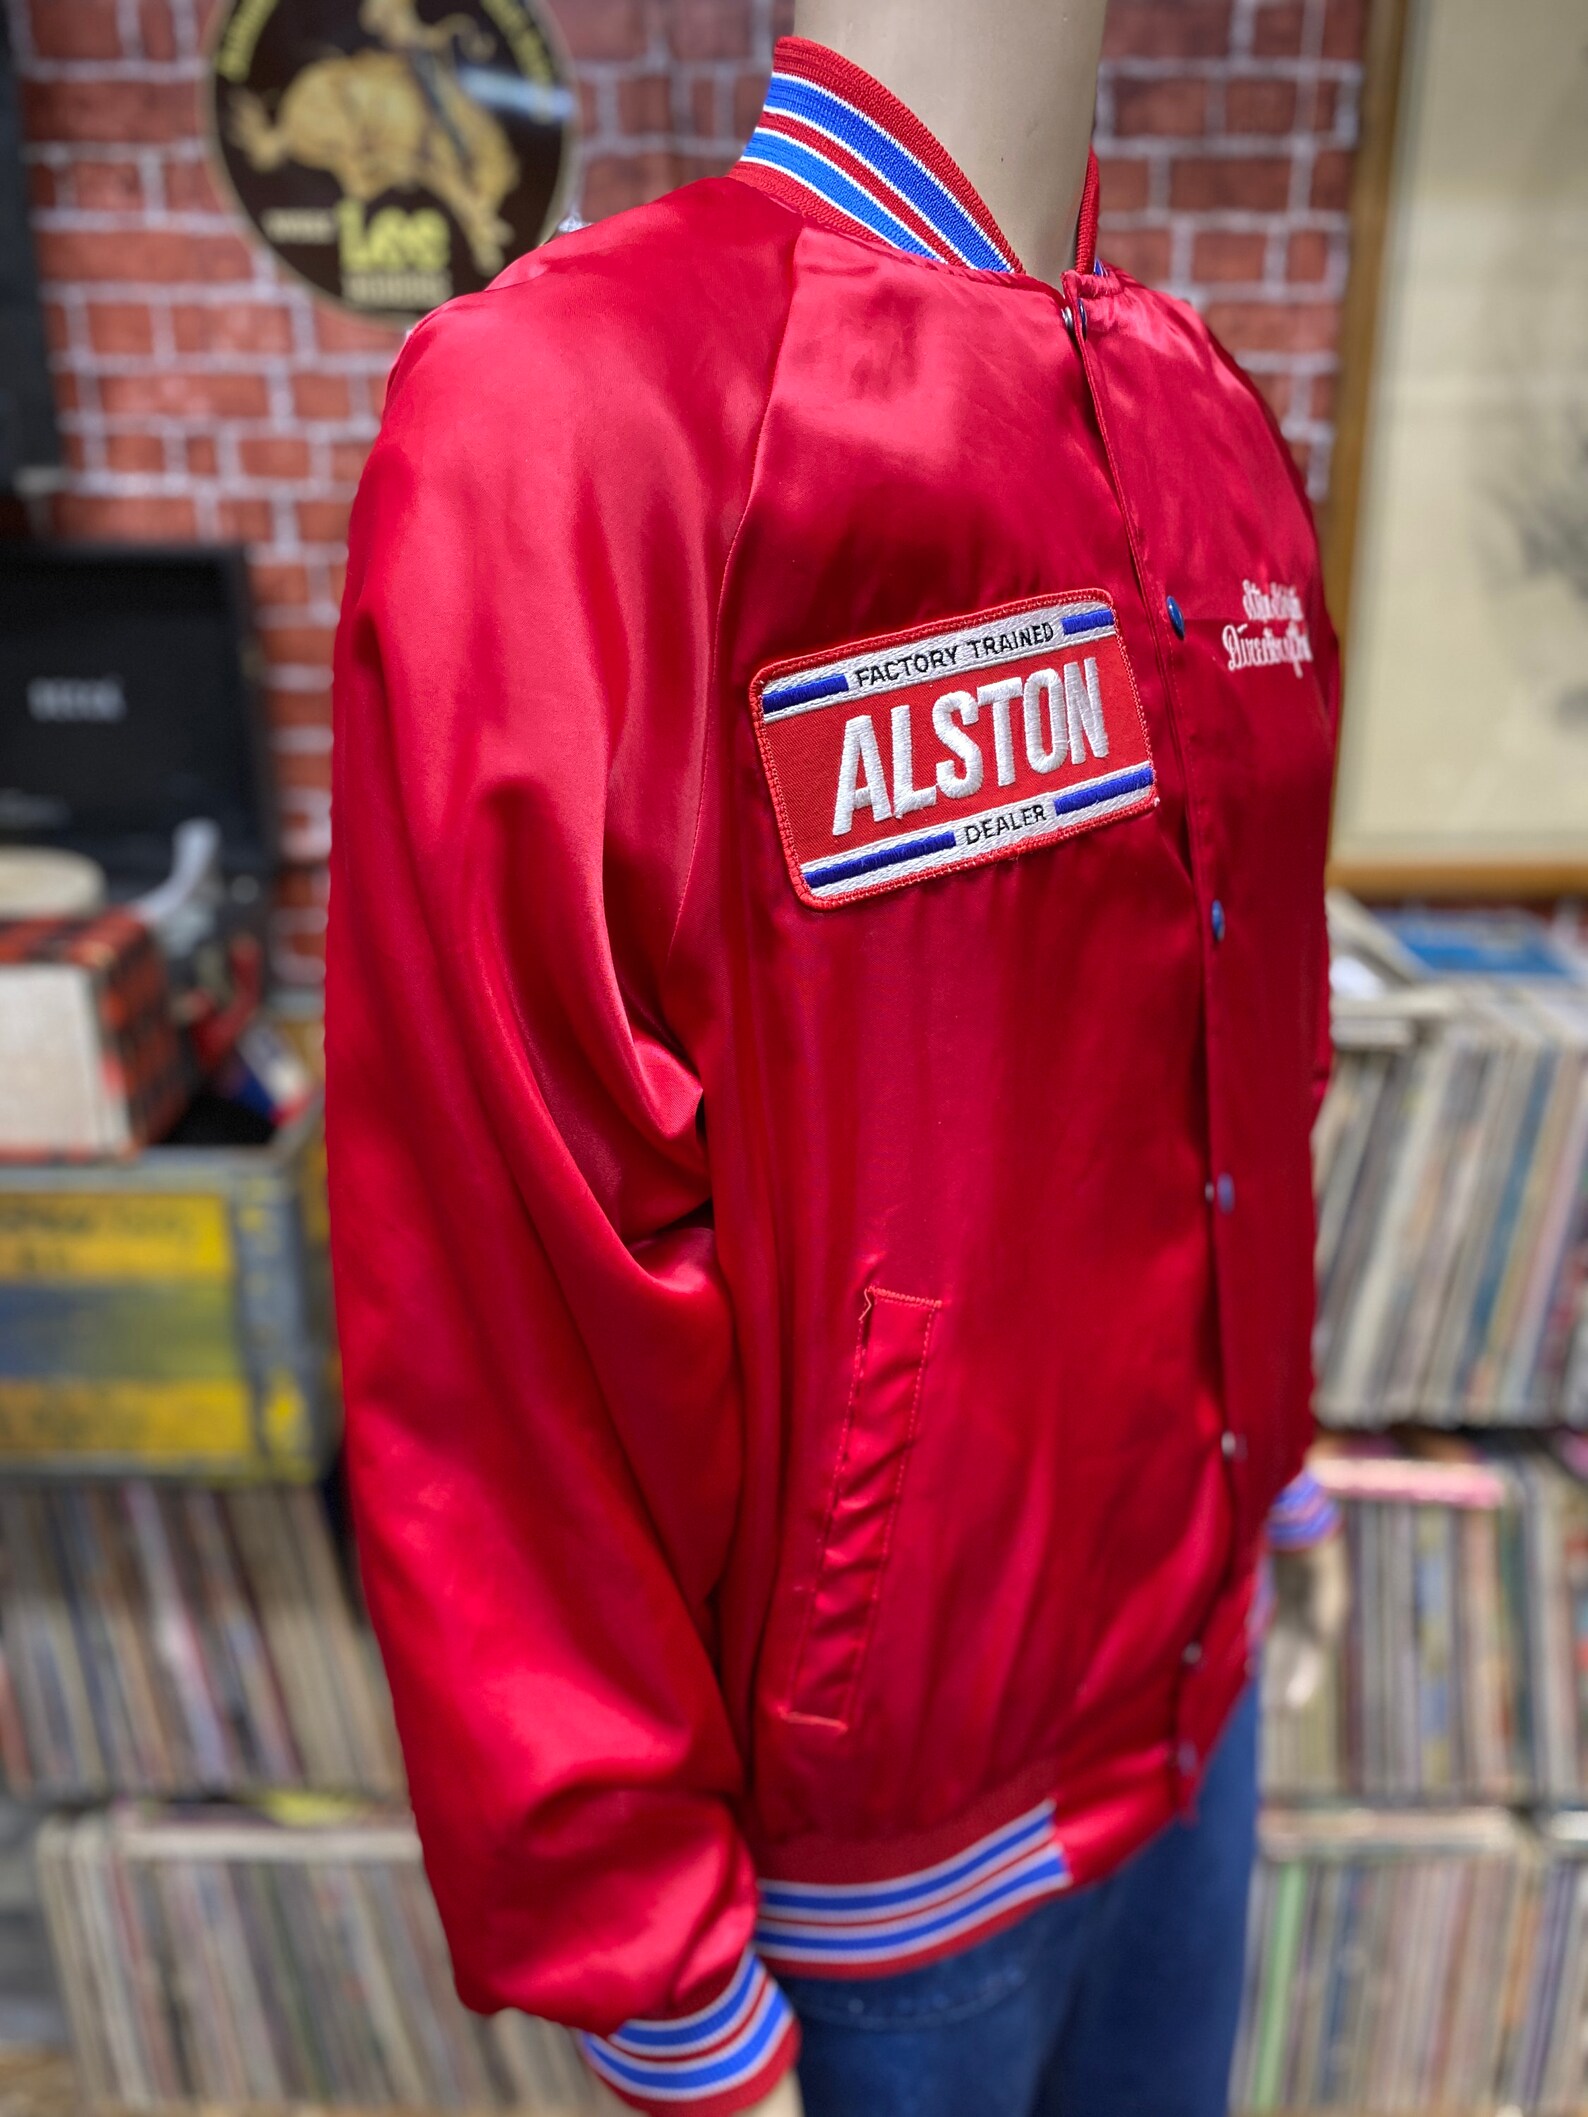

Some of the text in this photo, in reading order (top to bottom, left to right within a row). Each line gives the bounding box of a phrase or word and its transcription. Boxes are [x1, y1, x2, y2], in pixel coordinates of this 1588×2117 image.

[855, 622, 1054, 688] FACTORY TRAINED
[832, 657, 1109, 836] ALSTON
[964, 804, 1048, 845] DEALER
